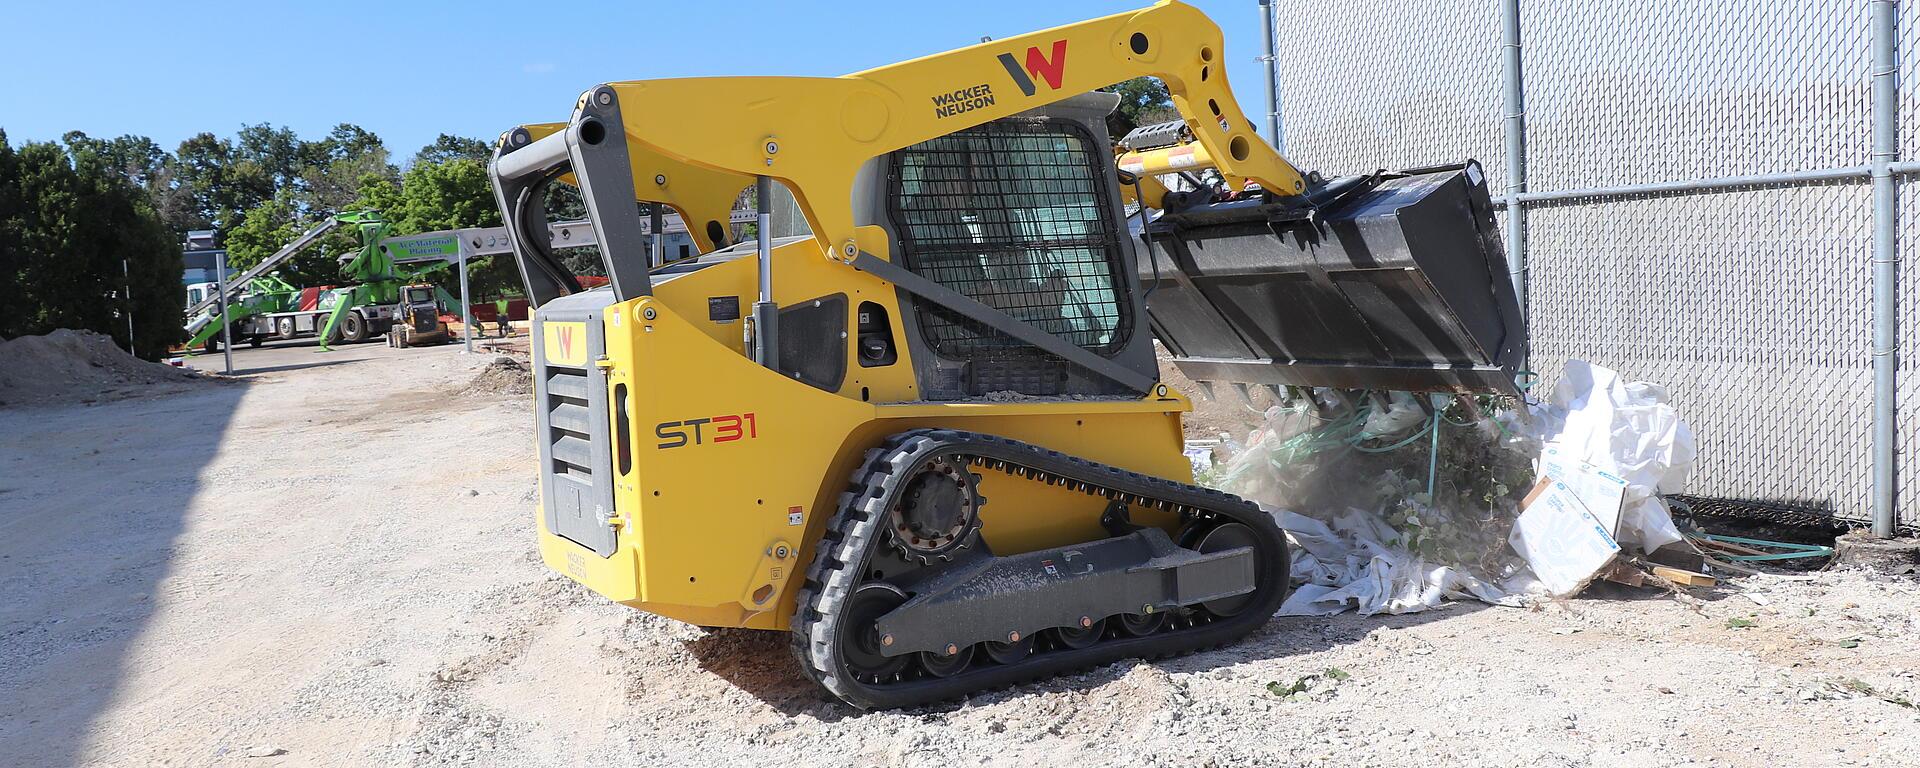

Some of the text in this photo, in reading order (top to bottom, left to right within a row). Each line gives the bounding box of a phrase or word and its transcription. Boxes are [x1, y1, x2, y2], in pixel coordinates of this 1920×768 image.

[932, 84, 992, 106] WACKER
[936, 95, 995, 119] NEUSON
[416, 238, 452, 247] Material
[655, 413, 756, 449] ST31
